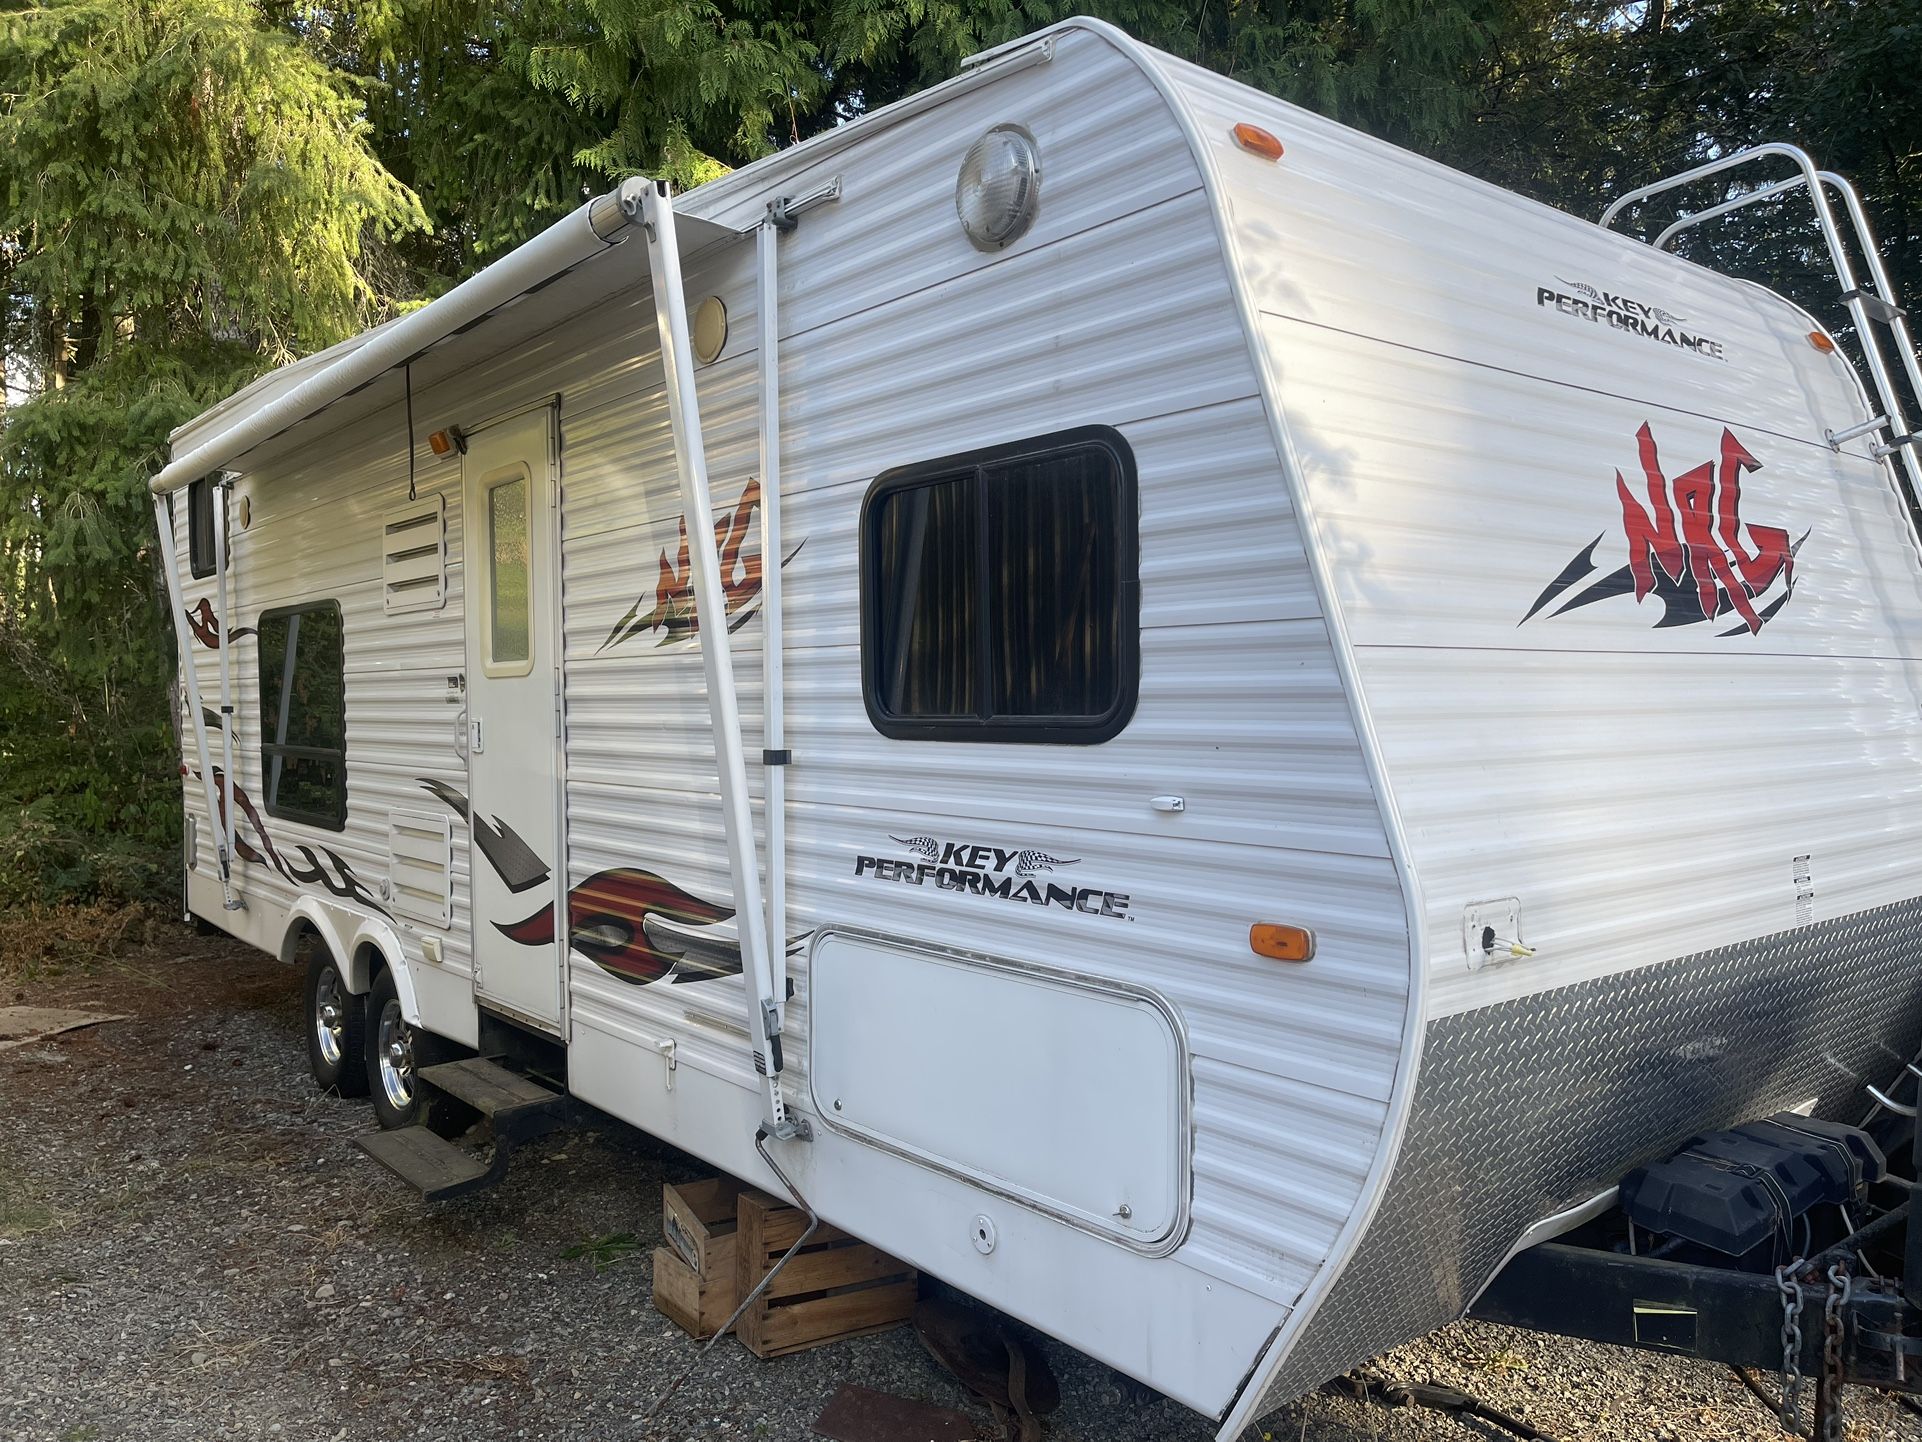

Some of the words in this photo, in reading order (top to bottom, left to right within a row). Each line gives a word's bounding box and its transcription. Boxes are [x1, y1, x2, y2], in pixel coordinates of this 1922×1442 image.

[1537, 286, 1723, 361] PERFORMANCE
[1602, 291, 1652, 319] KEY
[939, 842, 1019, 872] KEY
[854, 855, 1130, 919] PERFORMANCE
